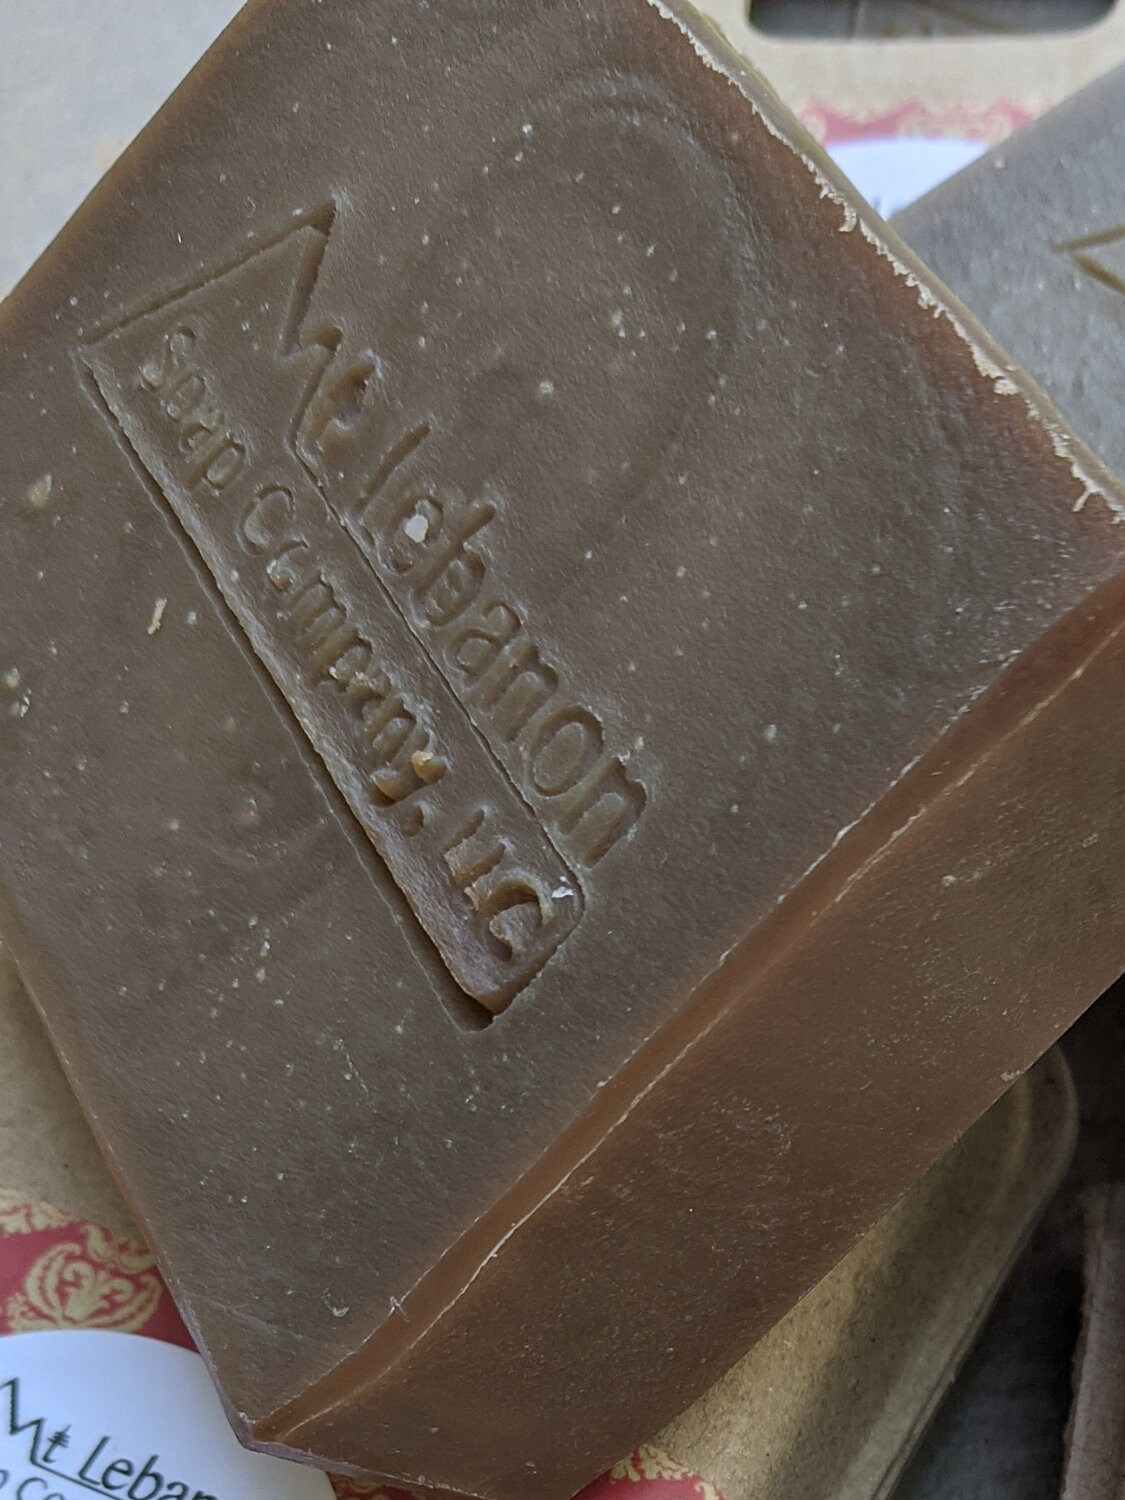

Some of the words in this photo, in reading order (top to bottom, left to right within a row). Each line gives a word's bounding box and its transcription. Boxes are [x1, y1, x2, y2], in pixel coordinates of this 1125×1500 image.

[139, 326, 246, 496] Soap
[444, 808, 552, 962] LLC
[355, 423, 648, 864] Lebanon
